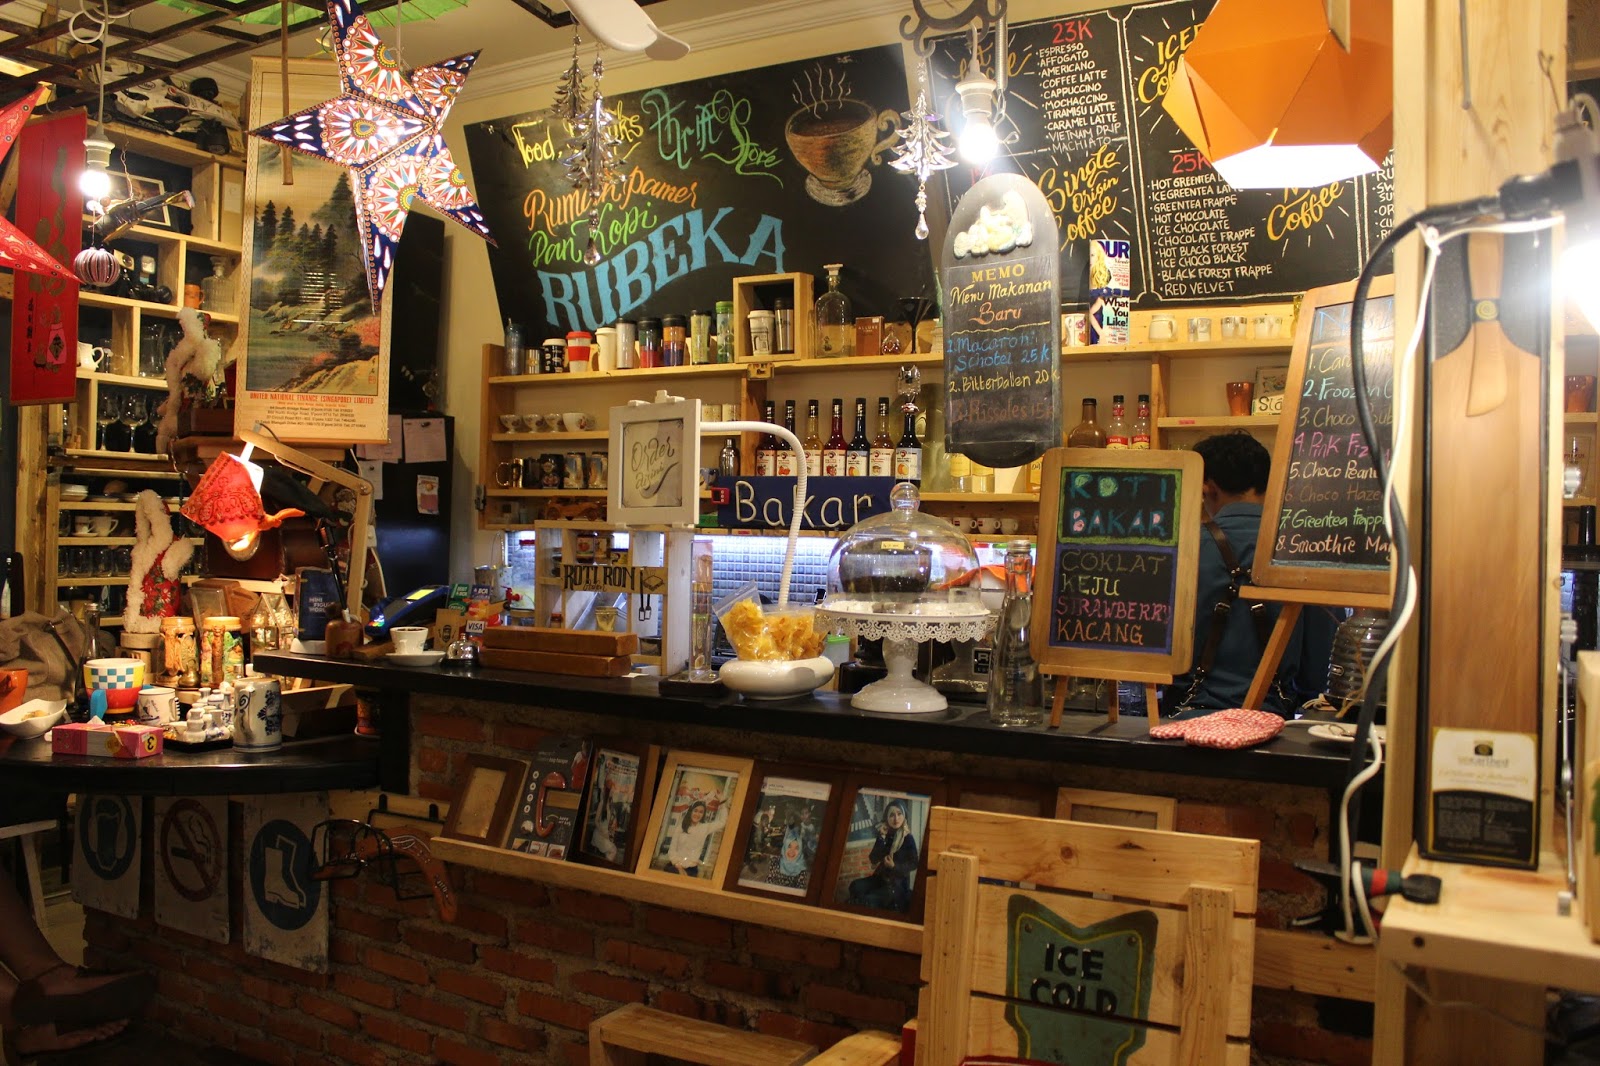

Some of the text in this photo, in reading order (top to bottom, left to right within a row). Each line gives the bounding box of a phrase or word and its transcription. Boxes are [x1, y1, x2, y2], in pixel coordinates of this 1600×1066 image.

[1052, 18, 1093, 43] 23K
[1039, 42, 1084, 58] ESPRESSO
[1040, 50, 1089, 67] AFFOGATO
[1041, 60, 1096, 78] AMERICANO
[1042, 70, 1108, 89] COFFEE LATTE
[1043, 82, 1102, 99] CAPPUCCINO
[1045, 93, 1108, 110] MOCHACCINO
[1046, 101, 1117, 119] TIRAMISU LATTE
[1047, 113, 1118, 130] CARAMEL LATTE
[1048, 128, 1094, 142] VIETNAM
[1052, 136, 1112, 154] MACHIATO
[1172, 150, 1212, 174] 25K
[1151, 178, 1172, 190] HOT
[1173, 173, 1216, 185] GREENTEA
[1072, 177, 1119, 213] Origin
[1154, 194, 1237, 214] GREENTEA FRAPPE
[1154, 208, 1228, 224] HOT CHOCOLATE
[1266, 181, 1345, 241] Coffee
[1156, 219, 1230, 235] ICE CHOCOLATE
[1157, 226, 1256, 247] CHOCOLATE FRAPPE
[1159, 242, 1249, 258] HOT BLACK FOREST
[1160, 251, 1247, 268] ICE CHOCO BLACK
[537, 206, 786, 333] RUBEKA
[972, 264, 1025, 283] MEMO
[1161, 268, 1196, 282] BLACK
[1197, 268, 1232, 279] FOREST
[950, 280, 1052, 307] Menu Makanan
[1164, 280, 1235, 296] RED VELVET
[969, 302, 1022, 325] Baru
[1106, 317, 1128, 327] Like!
[1112, 308, 1128, 317] You
[954, 352, 1012, 371] Schotel
[949, 381, 961, 393] 2.
[1303, 379, 1318, 397] 2.
[1300, 406, 1310, 427] 3.
[1313, 404, 1356, 428] Choco
[1290, 461, 1301, 479] 5.
[1303, 461, 1342, 479] Choco
[735, 480, 872, 528] Bakar
[1070, 508, 1167, 537] BAKAR
[1292, 508, 1348, 529] Greentea
[1275, 535, 1286, 551] 8.
[1289, 534, 1356, 555] Smoothie
[1062, 550, 1166, 576] COKLAT
[563, 565, 598, 591] ROTI
[603, 566, 636, 591] RON
[1061, 573, 1120, 597] KEJU
[1055, 595, 1172, 624] STRAWBERRY
[468, 622, 483, 631] VISA
[1057, 618, 1144, 646] KACANG
[1044, 943, 1104, 981] ICE
[1030, 977, 1118, 1017] COLD
